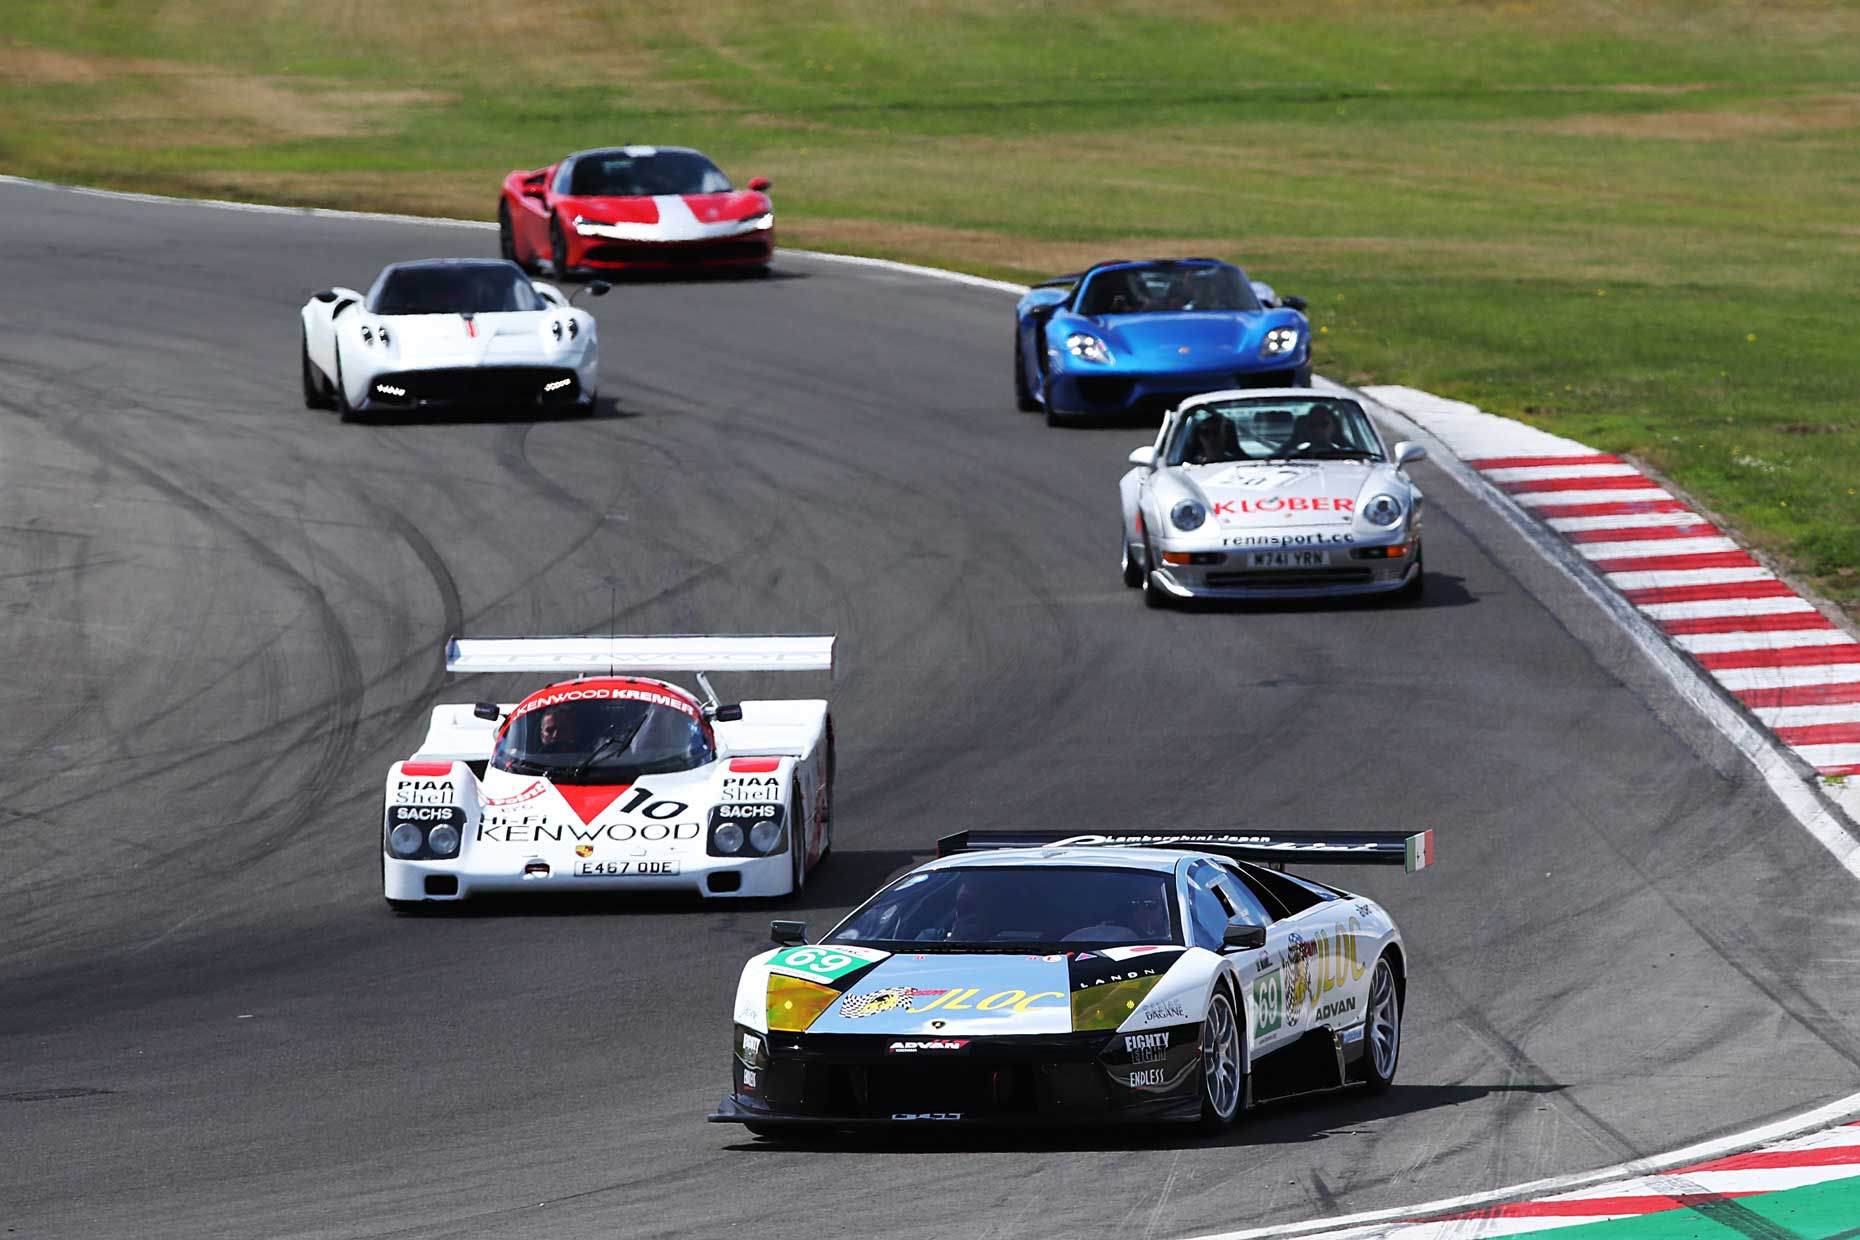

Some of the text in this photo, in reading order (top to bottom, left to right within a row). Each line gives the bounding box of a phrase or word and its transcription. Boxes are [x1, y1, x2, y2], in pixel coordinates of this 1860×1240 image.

[1222, 532, 1355, 547] rennsport.cc
[1294, 551, 1323, 567] YRN
[517, 688, 696, 717] KENWOOD KREMER
[397, 781, 454, 790] PIAA
[723, 777, 779, 787] PIAA
[396, 790, 454, 804] Shell
[721, 786, 779, 801] Shell
[620, 787, 689, 819] 10
[719, 805, 775, 818] SACHS
[397, 807, 453, 820] SACHS
[477, 823, 700, 841] KENWOOD
[1105, 834, 1271, 844] Lamborghini Japan
[582, 861, 673, 874] E467 ODE
[785, 949, 852, 972] 69
[1311, 915, 1367, 1009] JLOC
[905, 988, 1065, 1013] JLOC
[1260, 977, 1278, 1029] 69
[1315, 996, 1356, 1022] ADVAN
[889, 1041, 961, 1050] ADVAN
[1125, 1032, 1170, 1053] EIGHTY
[1132, 1045, 1168, 1065] EIGHT
[1129, 1068, 1165, 1088] ENDLESS
